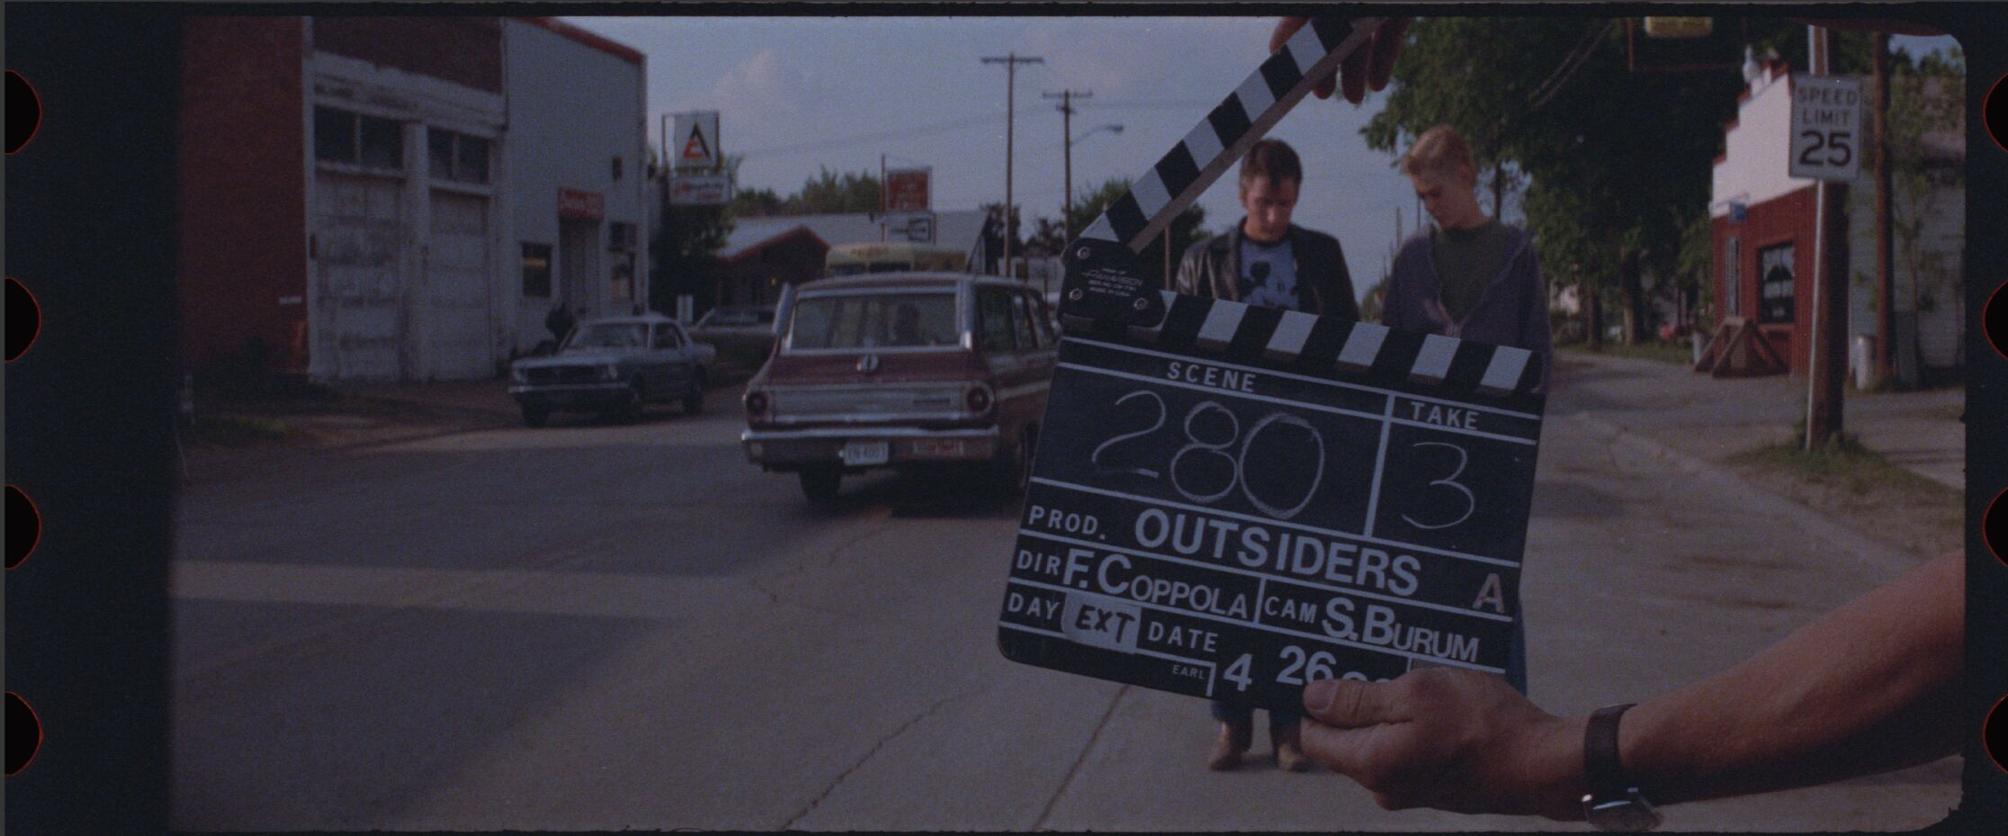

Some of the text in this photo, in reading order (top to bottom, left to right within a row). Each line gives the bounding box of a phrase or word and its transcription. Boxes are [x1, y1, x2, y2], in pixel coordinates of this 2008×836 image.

[1798, 86, 1857, 107] SPEED
[1802, 107, 1850, 127] LIMIT
[1799, 130, 1852, 168] 25
[1167, 361, 1257, 393] SCENE
[1411, 401, 1481, 431] TAKE
[1091, 389, 1326, 520] 280
[1402, 441, 1476, 530] 3
[1016, 549, 1062, 576] DIR
[1028, 505, 1422, 597] PROD. OUTSIDERS
[1264, 595, 1318, 625] CAM
[1472, 573, 1505, 614] A
[1007, 592, 1219, 653] DAY EXT DATE
[1172, 663, 1206, 681] EARL
[1223, 652, 1254, 692] 4
